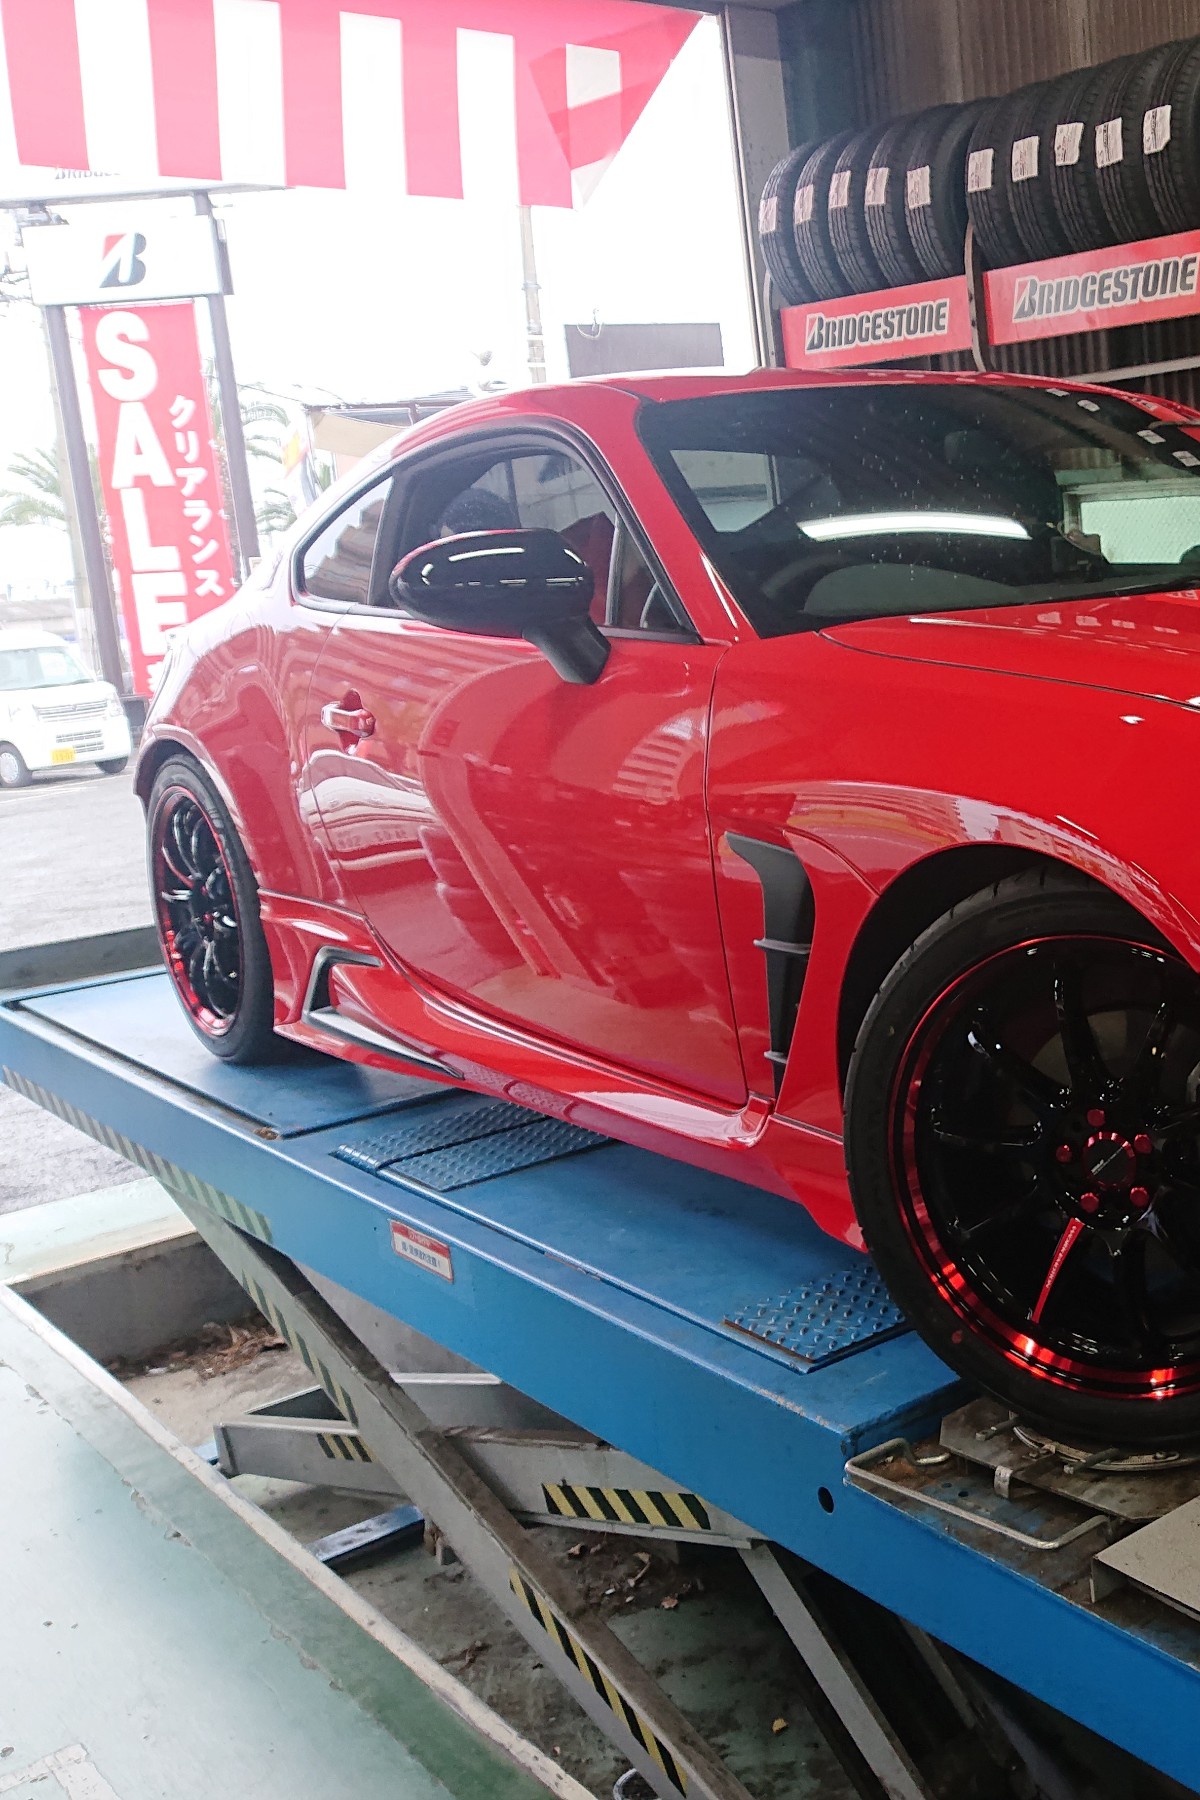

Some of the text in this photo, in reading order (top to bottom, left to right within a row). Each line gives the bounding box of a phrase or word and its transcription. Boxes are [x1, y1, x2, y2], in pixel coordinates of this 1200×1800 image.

[806, 301, 947, 353] BRIDGESTONE
[1014, 255, 1198, 321] BRIDGESTONE
[95, 310, 189, 657] SALE
[169, 394, 226, 598] クリアランス
